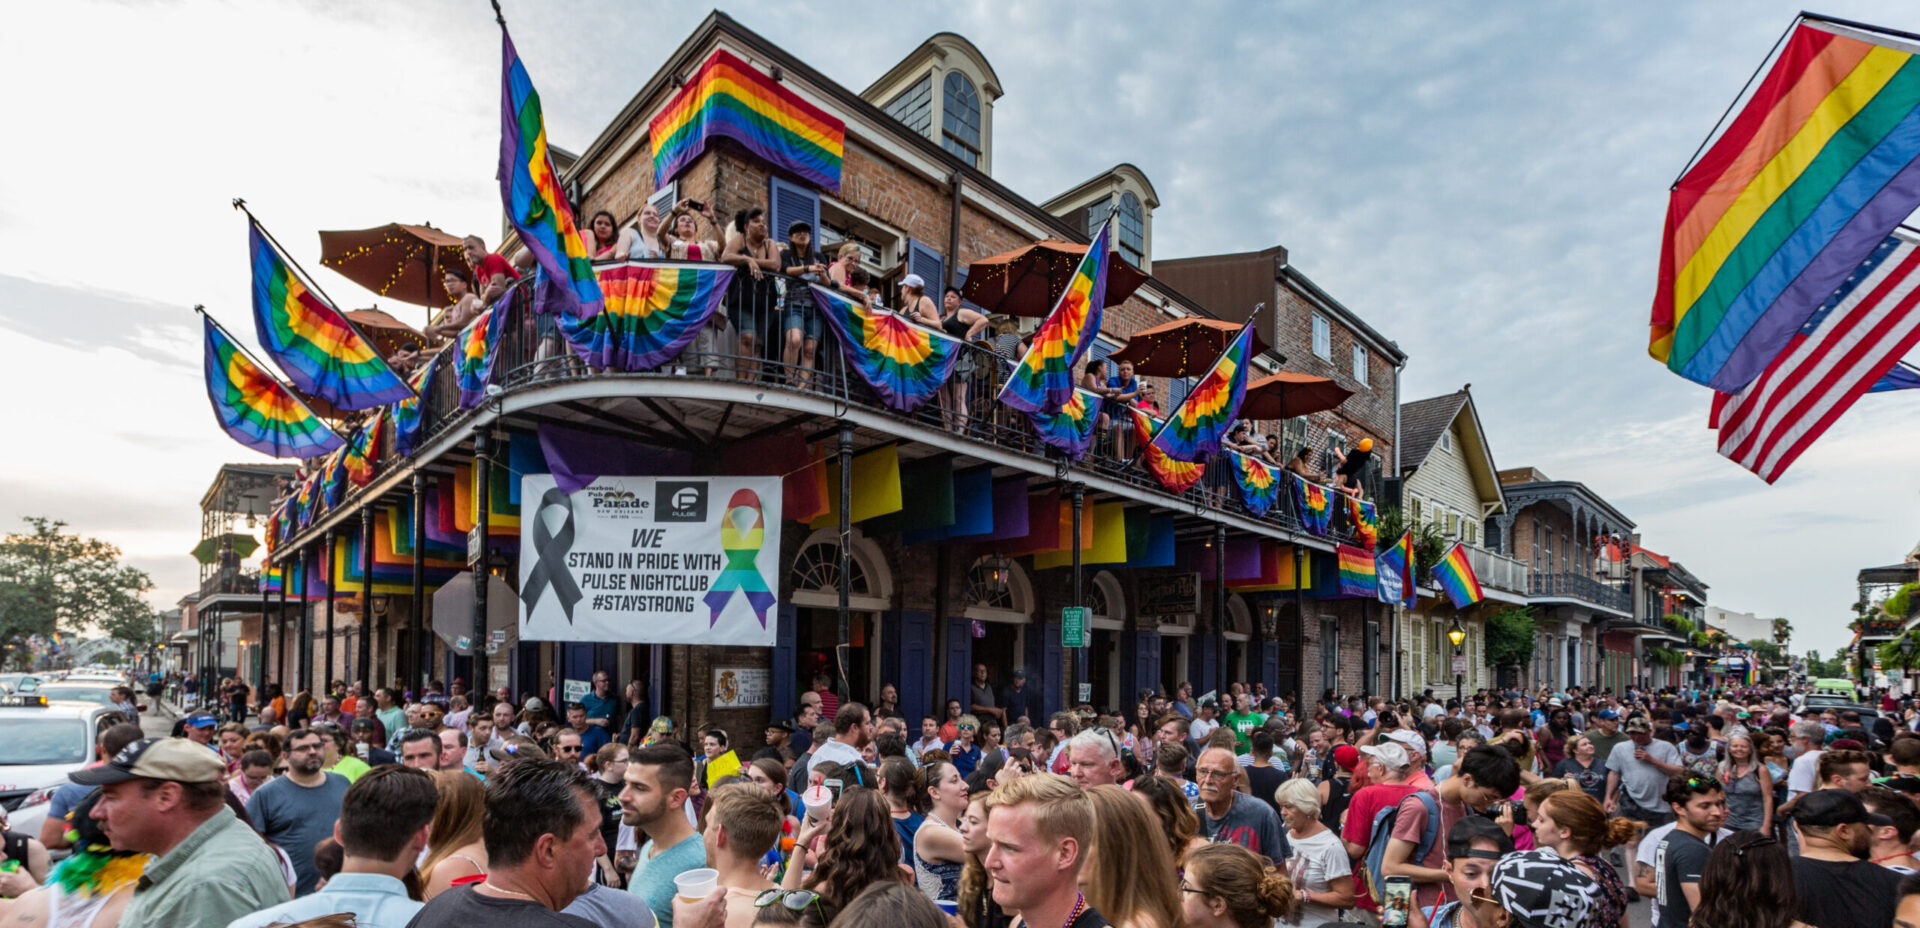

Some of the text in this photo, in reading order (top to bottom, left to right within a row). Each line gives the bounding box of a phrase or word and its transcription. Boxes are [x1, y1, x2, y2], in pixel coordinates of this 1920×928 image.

[593, 498, 649, 508] Parade
[631, 528, 666, 548] WE
[568, 552, 721, 571] STAND IN PRIDE WITH
[581, 573, 709, 591] PULSE NIGHTCLUB
[592, 594, 694, 612] #STAYSTRONG
